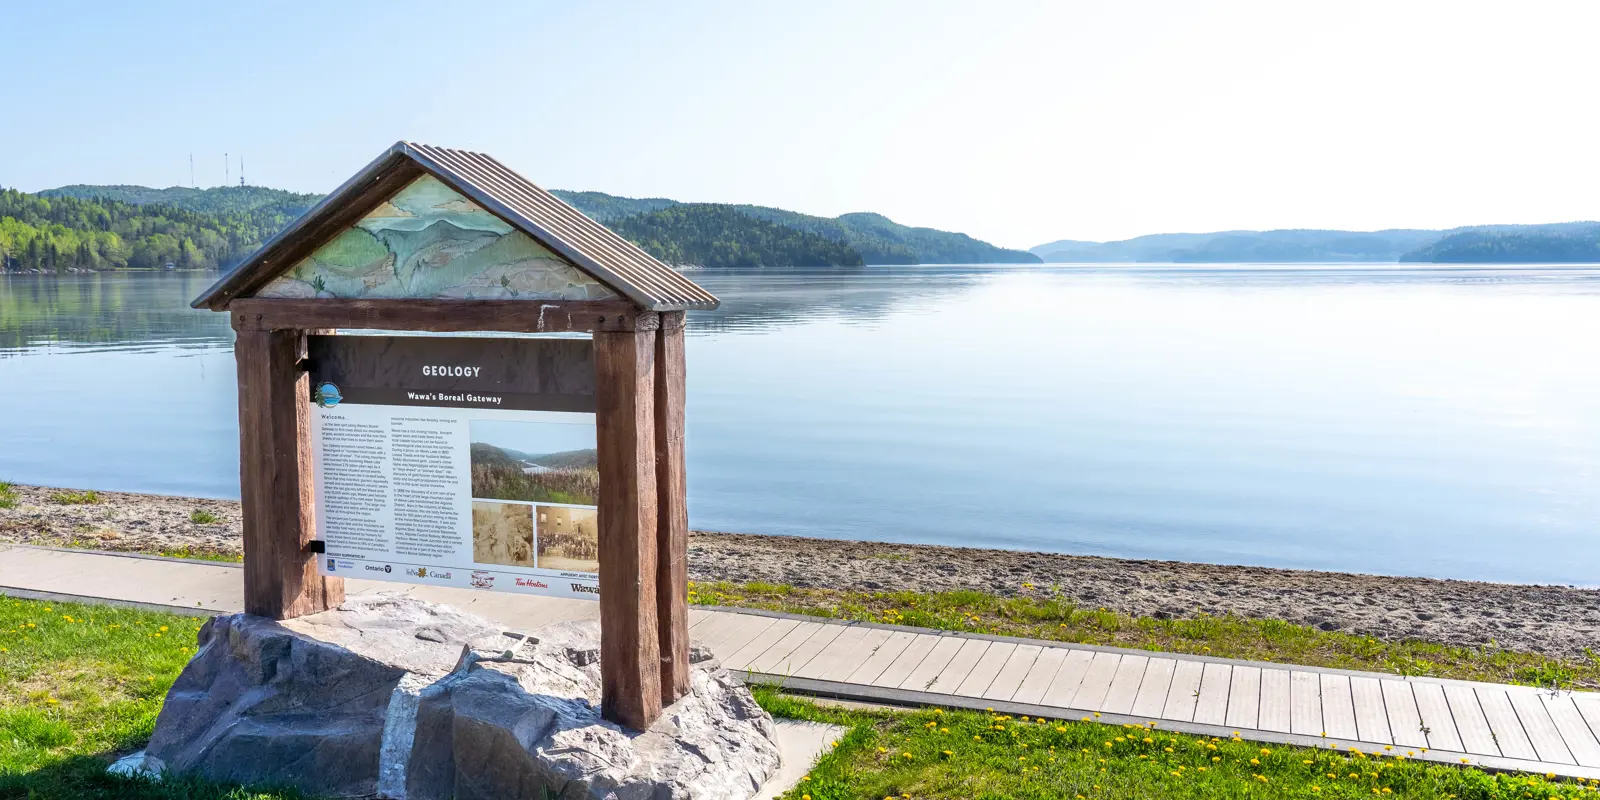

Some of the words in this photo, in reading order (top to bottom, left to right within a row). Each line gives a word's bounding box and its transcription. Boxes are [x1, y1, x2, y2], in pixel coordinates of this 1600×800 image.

[422, 366, 480, 377] GEOLOGY
[408, 392, 436, 400] Wawa's
[439, 393, 464, 402] Boreal
[467, 394, 502, 404] Gateway
[430, 571, 451, 579] Canada
[516, 578, 525, 586] Tim
[526, 579, 548, 588] Hortons
[570, 583, 600, 594] Wawa
